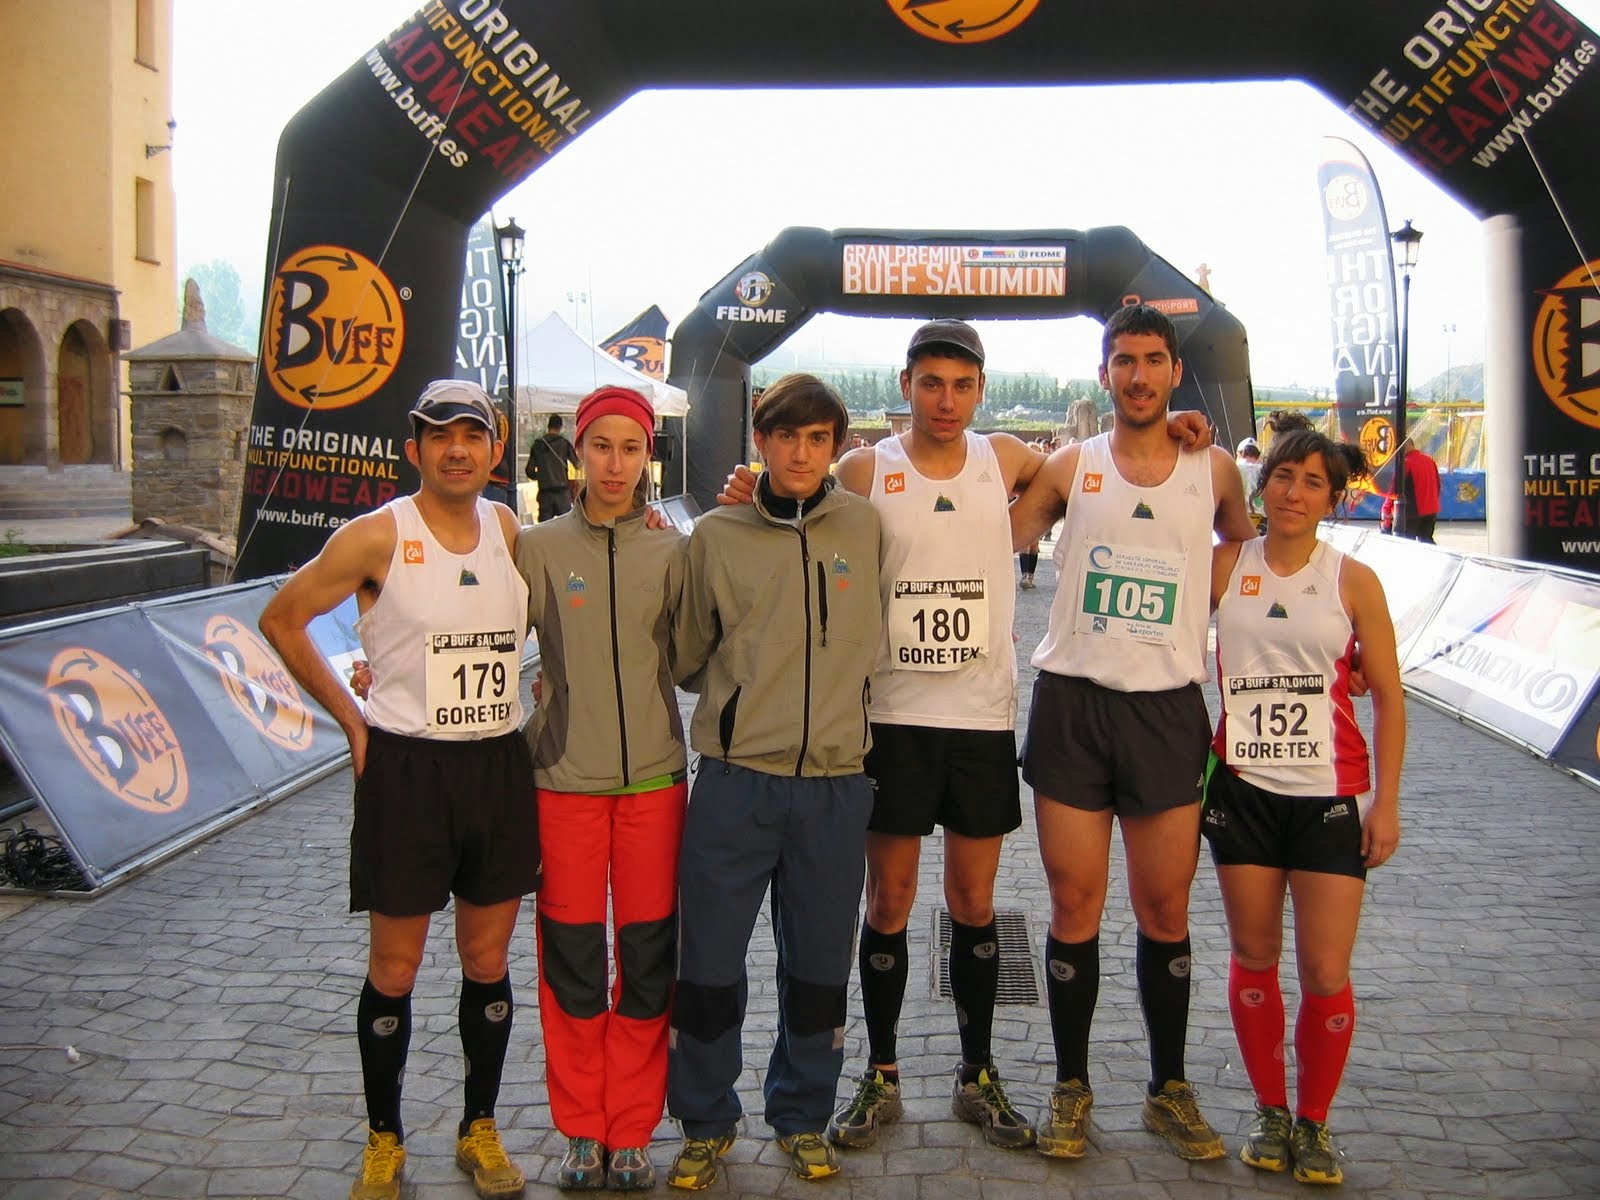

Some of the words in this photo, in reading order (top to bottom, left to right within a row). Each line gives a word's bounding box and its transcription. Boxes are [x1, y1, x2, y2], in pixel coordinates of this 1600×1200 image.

[421, 0, 562, 154] TIFUNCTIONAL
[459, 0, 591, 135] ORIGINAL
[365, 48, 469, 168] www.buff.es
[385, 17, 542, 181] ADWEAR
[1472, 40, 1597, 168] www.buff.es
[843, 244, 890, 264] GRAN
[895, 245, 961, 266] PREMIO
[1030, 250, 1061, 258] FEDME
[844, 262, 917, 295] BUFF
[925, 262, 1065, 296] SALOMON
[273, 270, 396, 373] BUFF
[716, 306, 787, 323] FEDME
[612, 343, 665, 373] BU
[250, 425, 275, 446] THE
[282, 428, 400, 460] ORIGINAL
[1523, 454, 1576, 476] THE
[256, 508, 351, 529] www.buff.es
[1524, 499, 1600, 528] HEA
[896, 581, 909, 593] GP
[910, 581, 934, 593] BUFF
[936, 580, 983, 594] SALOMON
[1095, 578, 1165, 621] 105
[434, 635, 449, 648] GP
[451, 634, 475, 647] BUFF
[476, 632, 516, 646] SALOMON
[912, 608, 970, 642] 180
[453, 661, 506, 700] 179
[1230, 678, 1244, 690] GP
[1246, 677, 1271, 689] BUFF
[1272, 675, 1323, 689] SALOMON
[40, 679, 180, 792] BUFF
[1249, 702, 1308, 737] 152
